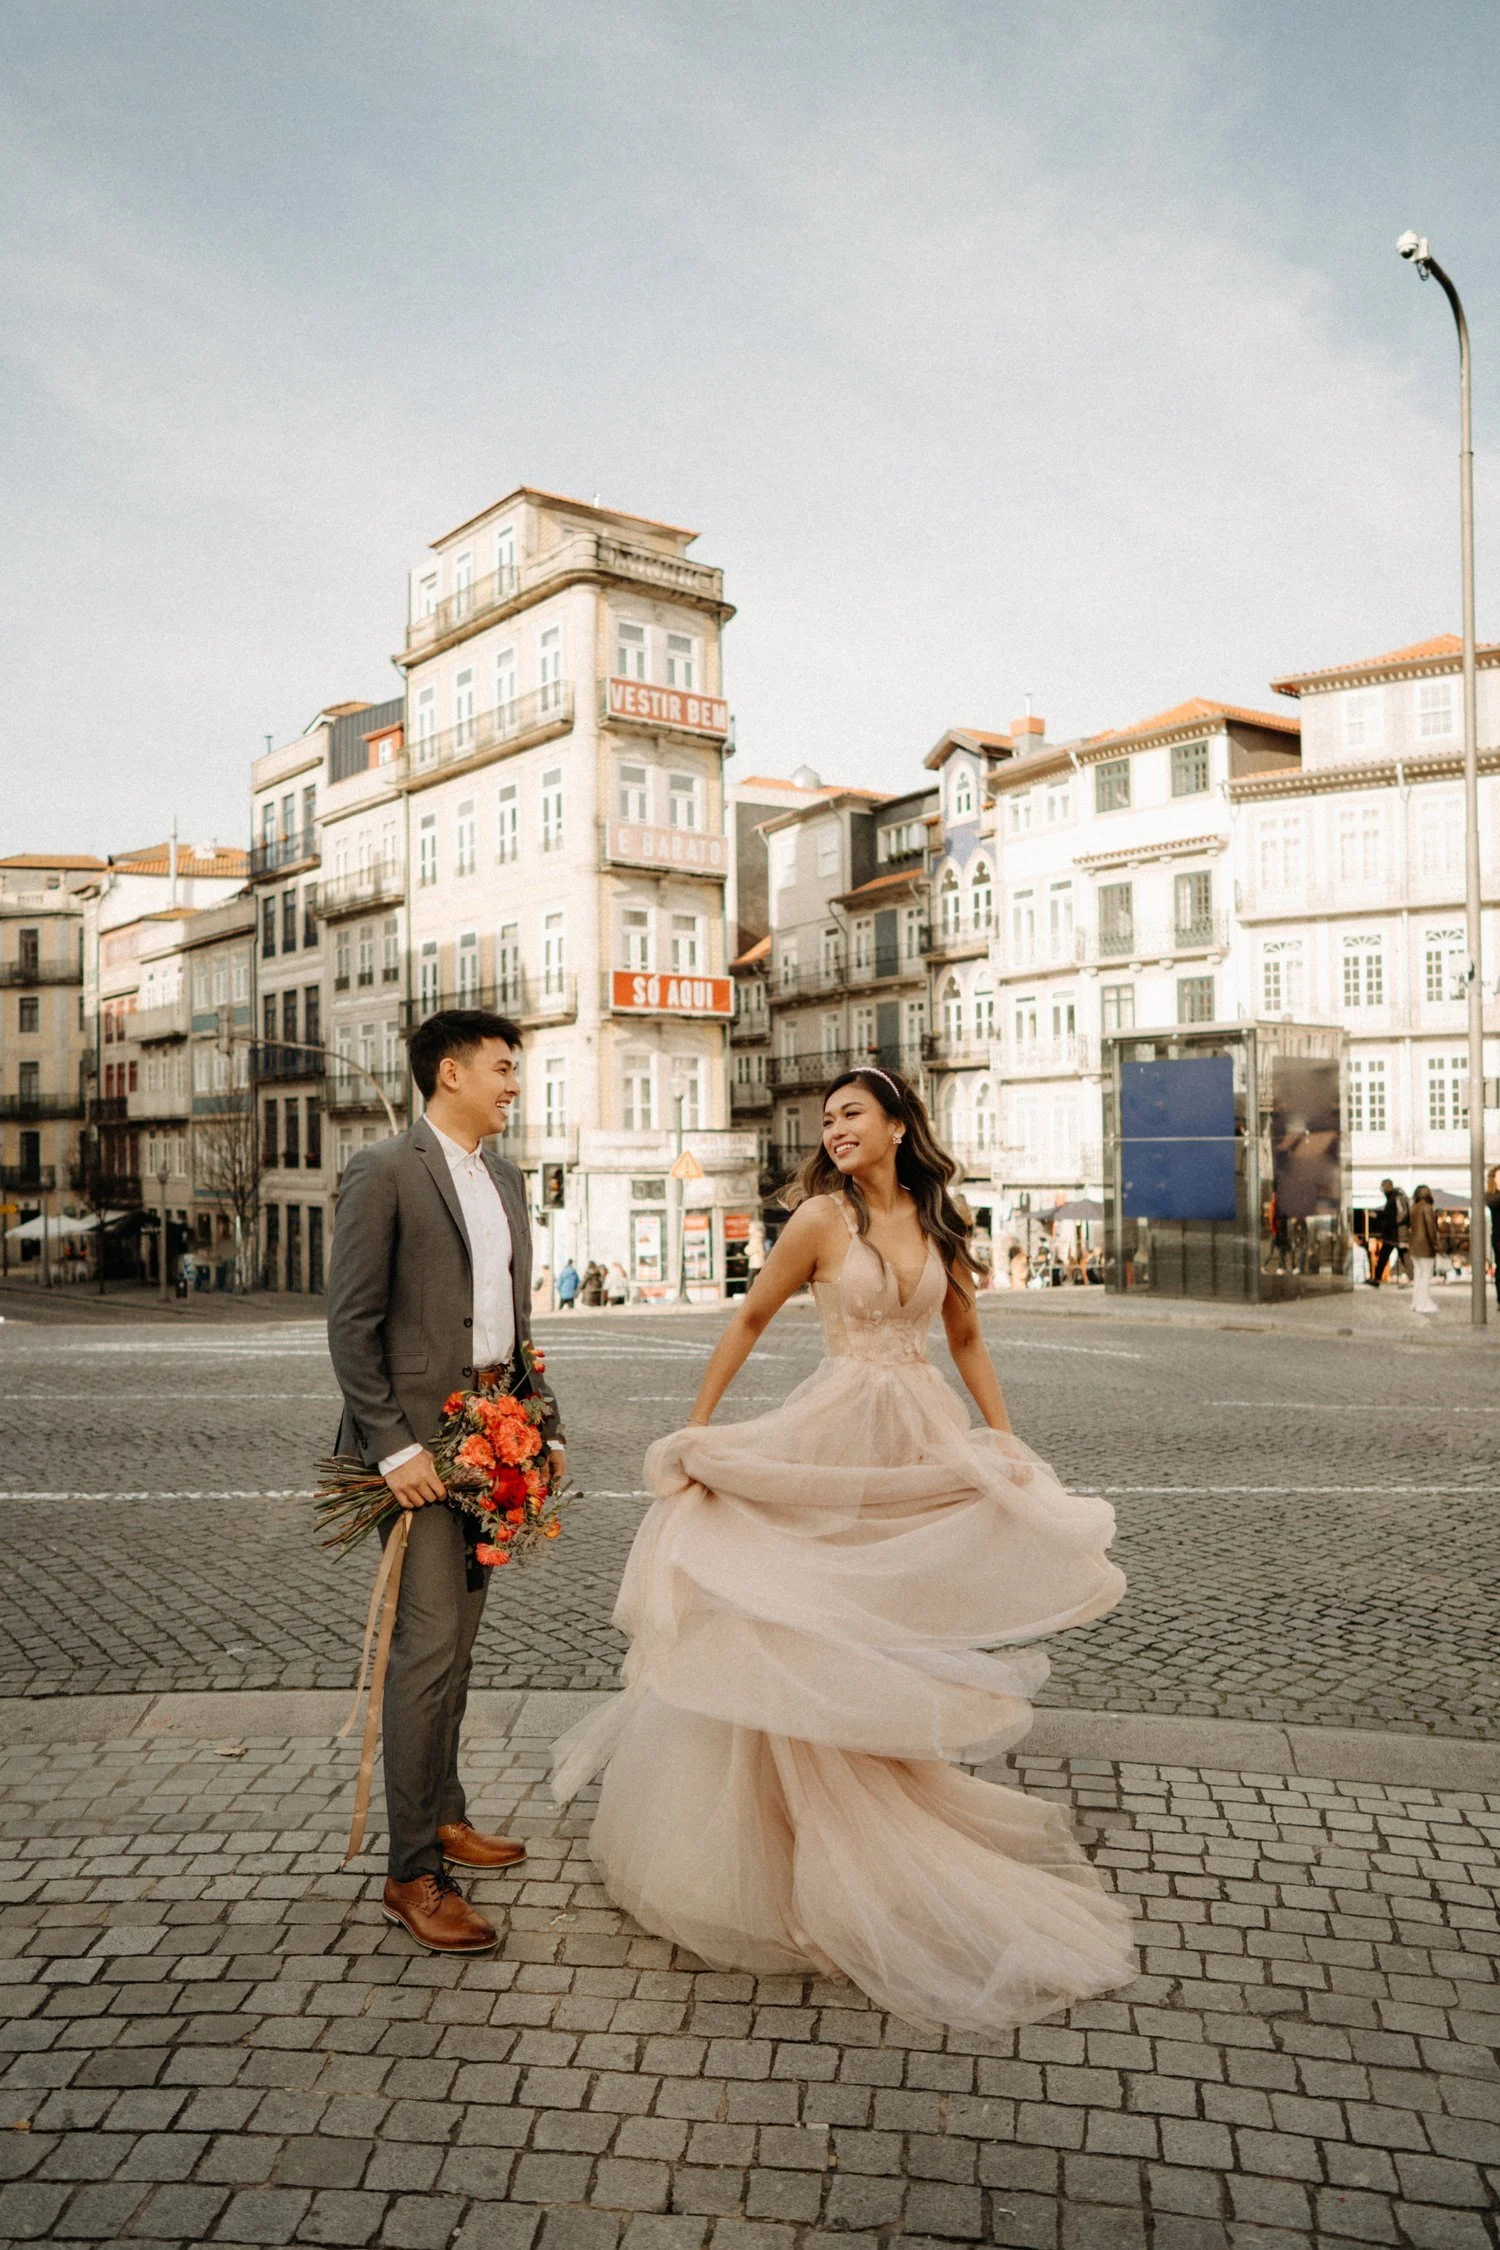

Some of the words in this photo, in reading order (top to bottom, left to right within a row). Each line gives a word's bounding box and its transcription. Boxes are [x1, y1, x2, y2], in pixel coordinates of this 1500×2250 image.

[611, 683, 682, 721] VESTIR
[687, 698, 726, 729] BEM
[641, 832, 722, 866] BARATO
[632, 975, 661, 1006] SÓ
[667, 979, 714, 1009] AQUI
